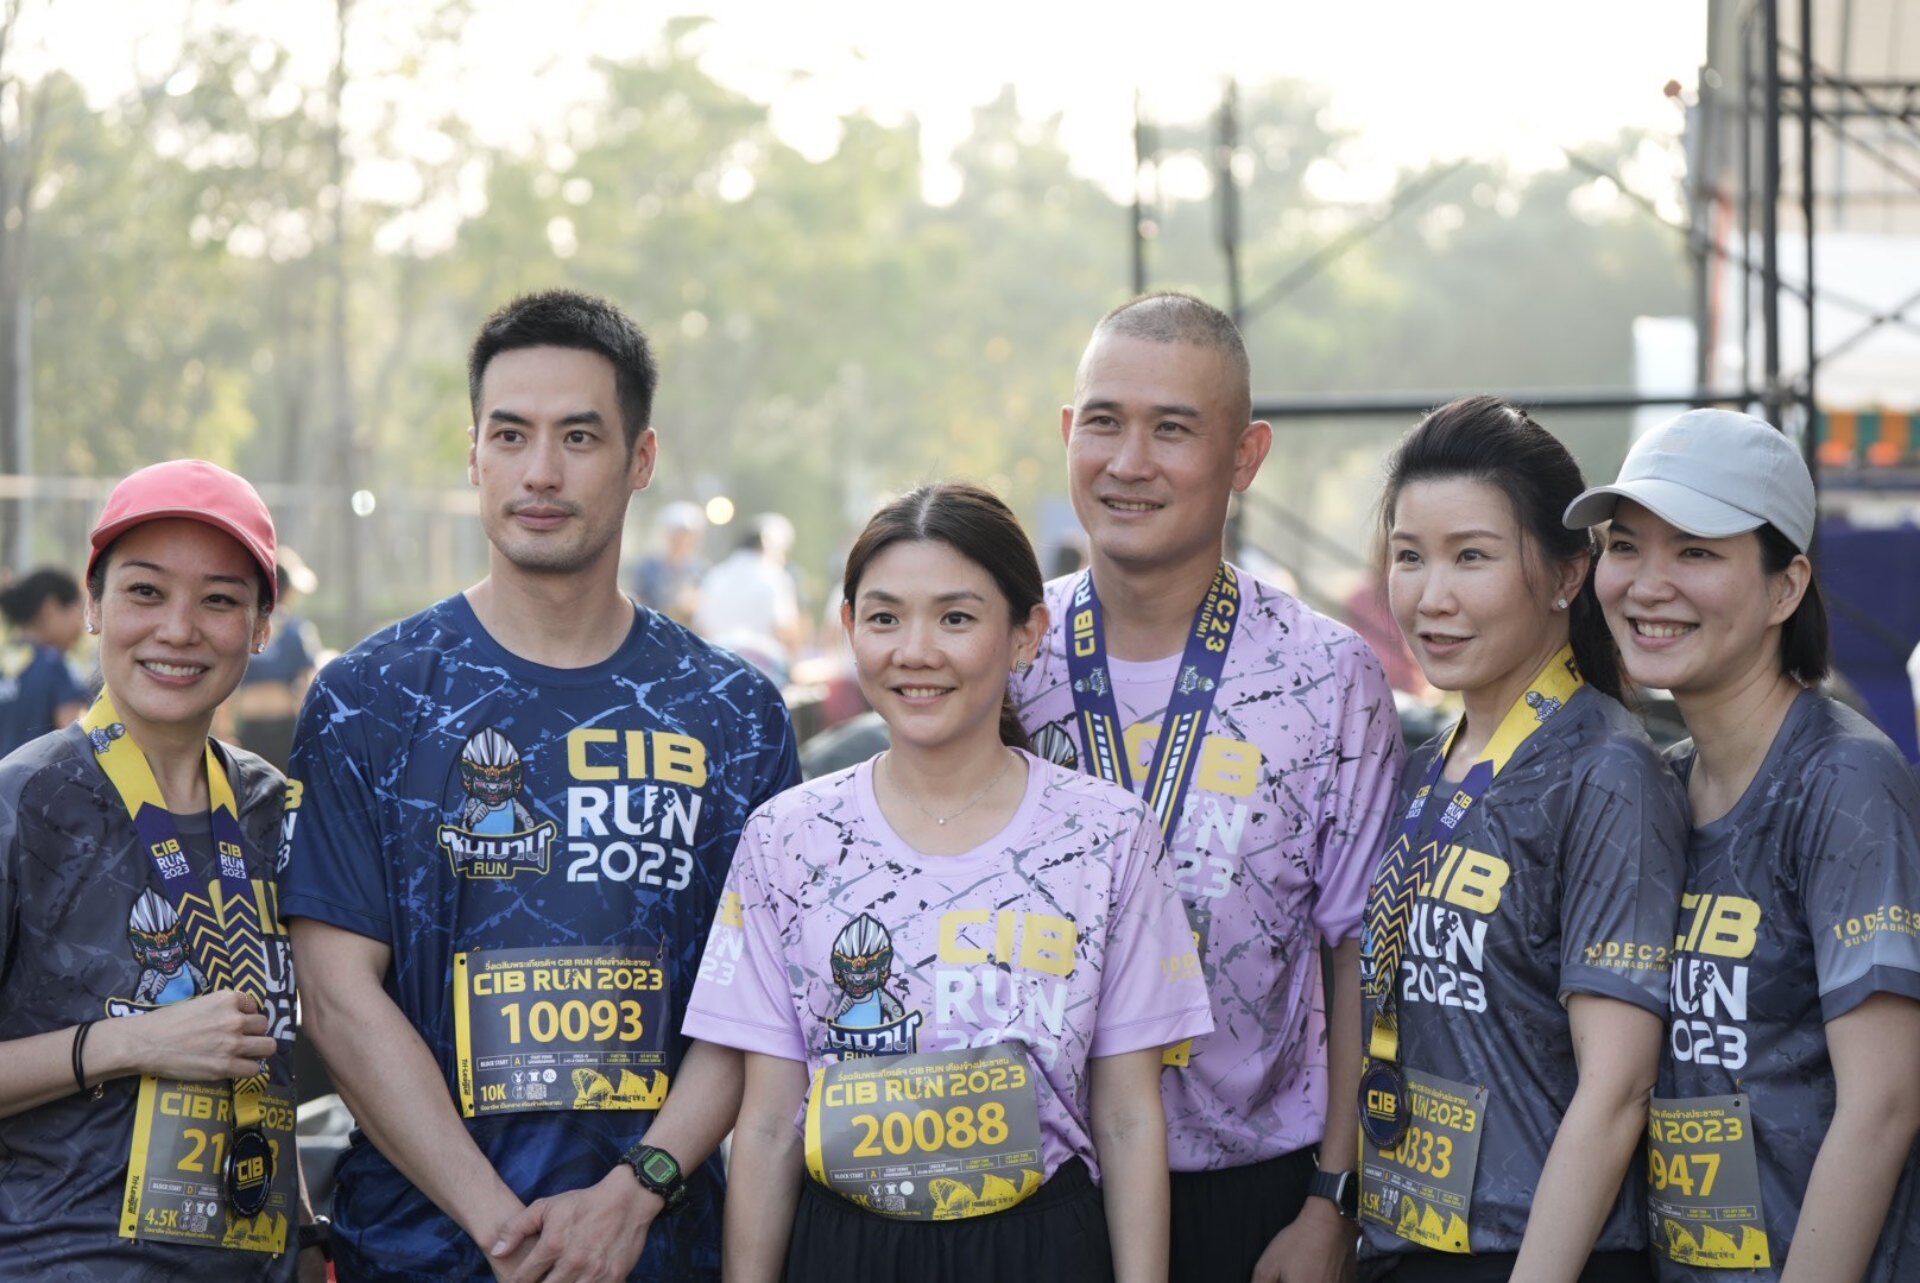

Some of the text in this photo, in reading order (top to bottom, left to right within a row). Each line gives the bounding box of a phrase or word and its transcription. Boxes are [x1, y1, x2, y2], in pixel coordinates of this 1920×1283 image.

[1074, 609, 1096, 658] CIB
[567, 728, 708, 788] CIB
[1446, 802, 1465, 821] RUN
[1453, 790, 1472, 809] CIB
[567, 785, 703, 846] RUN
[1440, 813, 1458, 829] 2023
[151, 838, 181, 857] CIB
[218, 841, 243, 858] CIB
[156, 852, 186, 870] RUN
[163, 864, 190, 879] 2023
[220, 855, 245, 869] RUN
[222, 866, 247, 879] 2023
[474, 862, 507, 875] RUN
[567, 841, 694, 891] 2023
[939, 908, 1078, 976] CIB
[574, 958, 593, 966] RUN
[473, 968, 663, 995] CIB RUN 2023
[1402, 961, 1488, 1013] 2023
[936, 969, 1068, 1040] RUN
[501, 1000, 644, 1044] 10093
[1672, 1019, 1748, 1070] 023
[909, 1066, 925, 1076] CIB
[925, 1064, 945, 1074] RUN
[481, 1084, 506, 1102] 10K
[825, 1065, 1026, 1107] CIB RUN 2023
[160, 1092, 213, 1119] CIB
[1367, 1090, 1398, 1113] CIB
[1428, 1099, 1476, 1132] 2023
[851, 1102, 1009, 1158] 20088
[1665, 1118, 1743, 1144] 2023
[236, 1156, 264, 1182] CIB
[1650, 1148, 1721, 1196] 947
[145, 1207, 179, 1228] 4.5K
